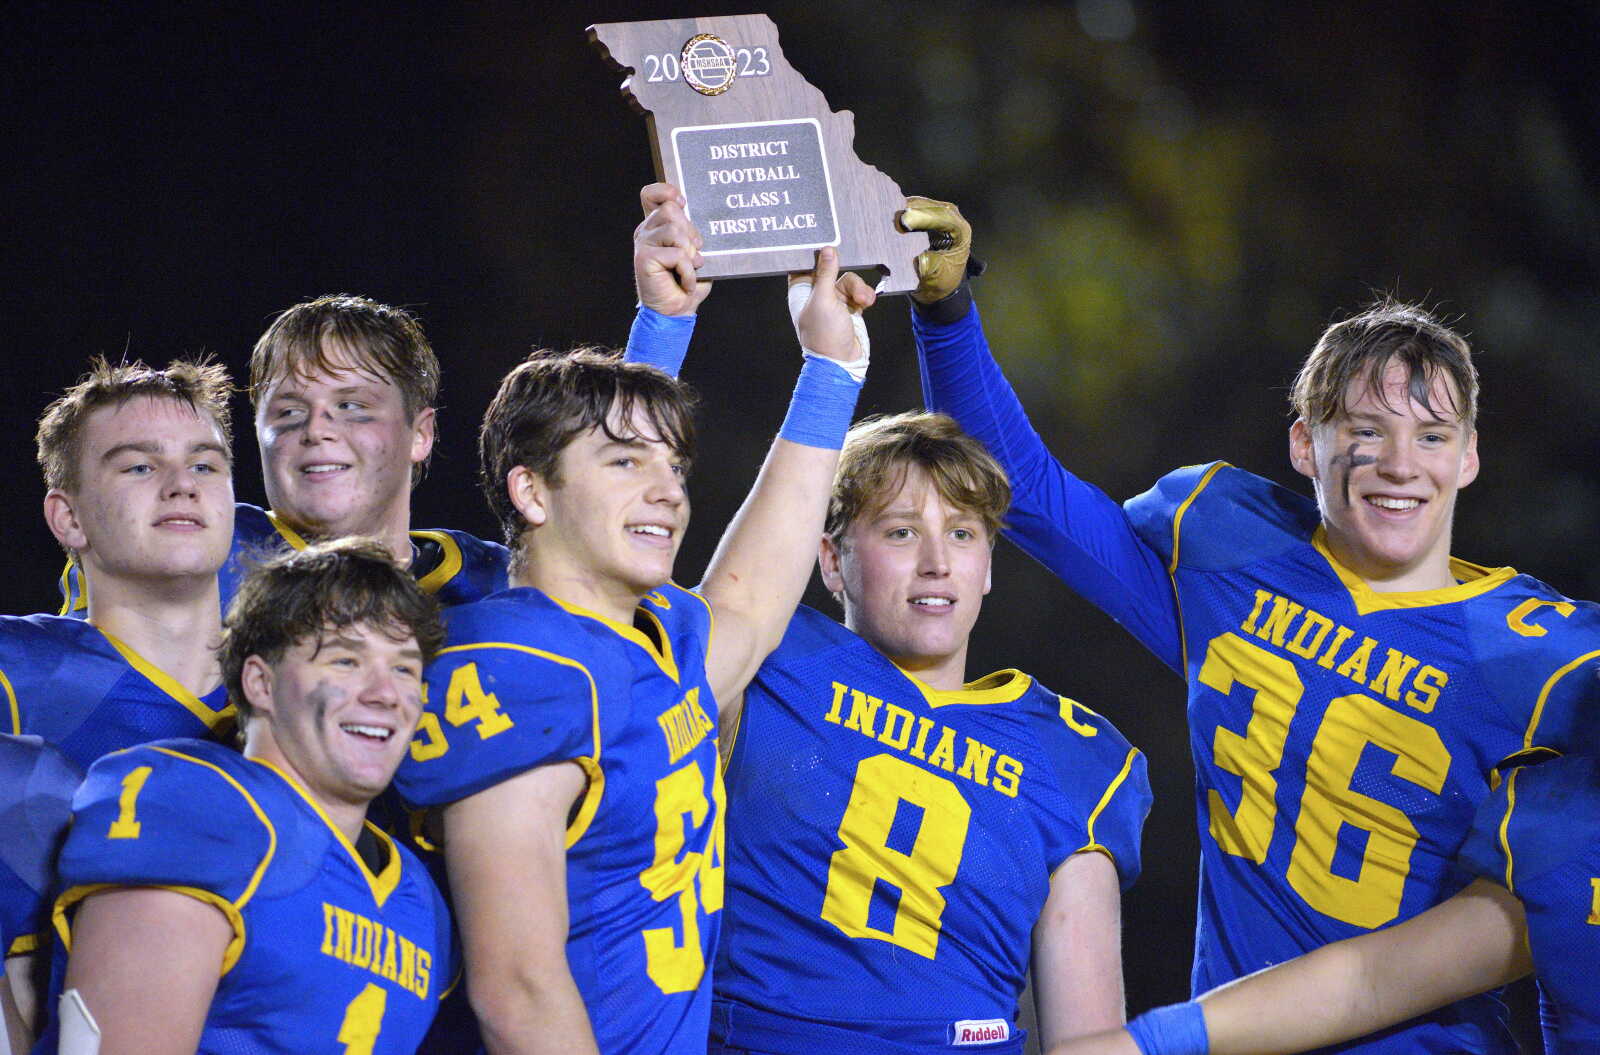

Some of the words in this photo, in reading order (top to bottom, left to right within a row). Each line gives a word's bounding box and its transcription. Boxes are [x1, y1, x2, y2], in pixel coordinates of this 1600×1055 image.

[644, 53, 680, 83] 20
[736, 47, 770, 77] 23
[708, 164, 800, 185] FOOTBALL
[709, 140, 789, 160] DISTRICT
[708, 217, 758, 236] FIRST
[760, 213, 817, 232] PLACE
[725, 191, 780, 209] CLASS
[782, 189, 792, 205] 1
[1506, 597, 1576, 637] C
[1241, 589, 1449, 714] INDIANS
[408, 662, 514, 763] 54
[825, 681, 1024, 799] INDIANS
[107, 766, 153, 840] 1
[1198, 632, 1452, 930] 36
[820, 752, 973, 961] 8
[321, 902, 432, 1000] INDIANS
[336, 981, 388, 1055] 1
[960, 1025, 1006, 1042] Riddell
